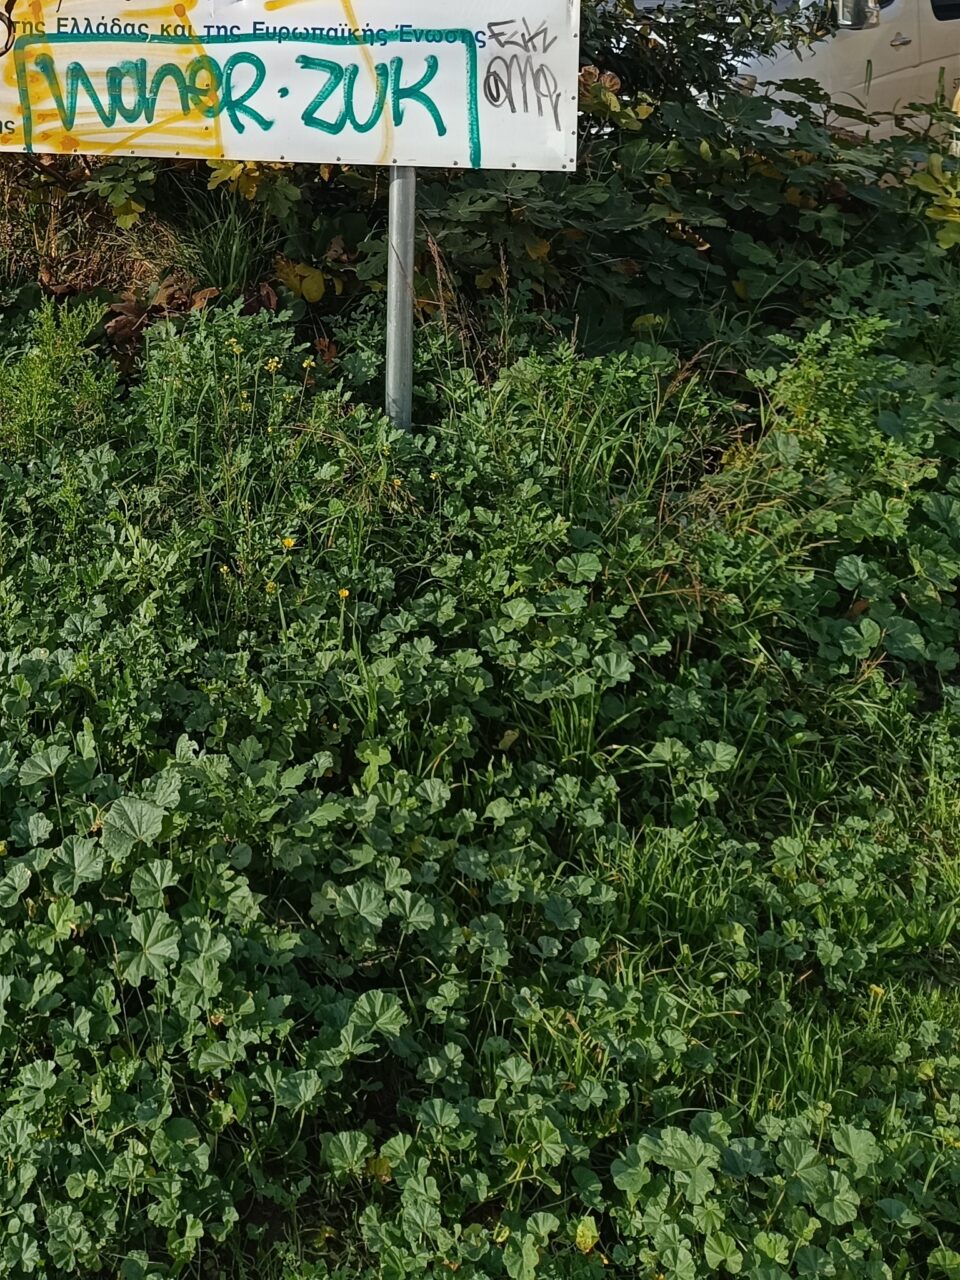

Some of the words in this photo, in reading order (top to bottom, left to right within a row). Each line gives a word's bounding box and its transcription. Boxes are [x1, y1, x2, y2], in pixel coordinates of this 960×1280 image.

[57, 16, 149, 41] Ελλάδας
[160, 21, 193, 38] και
[203, 24, 241, 41] της
[252, 21, 388, 47] Ευρωπαϊκής
